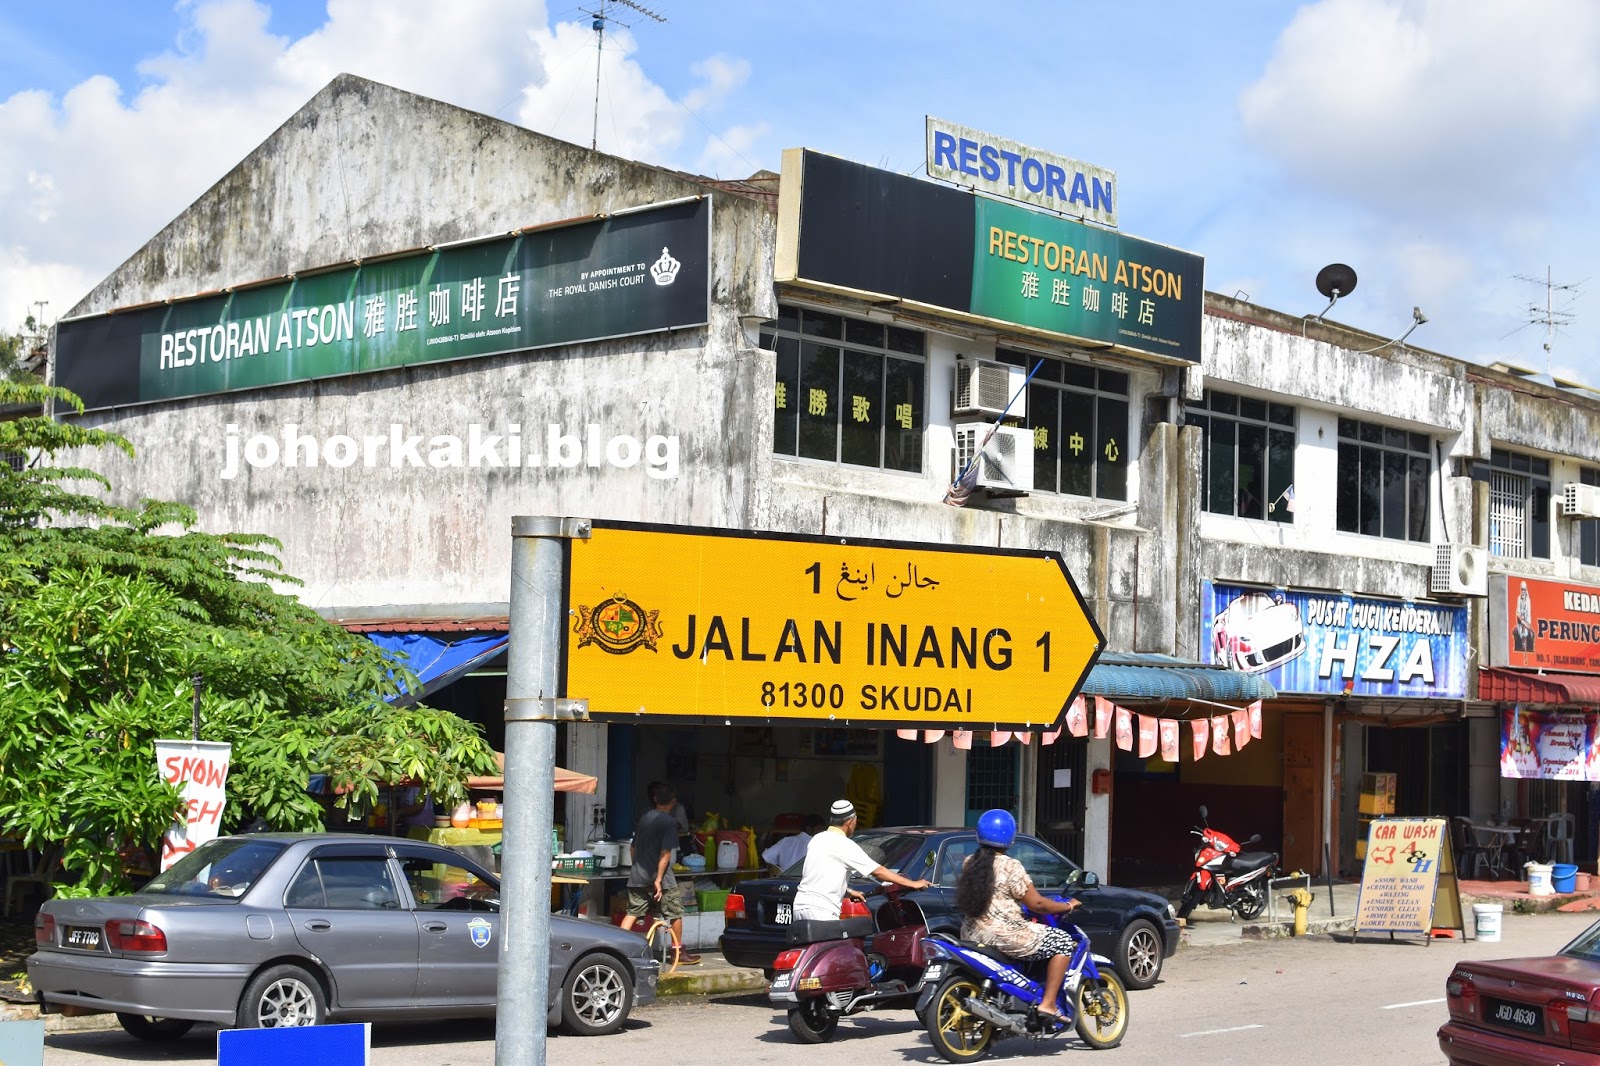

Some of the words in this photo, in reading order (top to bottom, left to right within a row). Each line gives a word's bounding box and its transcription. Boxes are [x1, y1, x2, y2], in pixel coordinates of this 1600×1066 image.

[934, 130, 1113, 214] RESTORAN
[581, 272, 588, 280] BY
[590, 264, 635, 279] APPOINTMENT
[637, 262, 646, 270] TO
[989, 226, 1109, 282] RESTORAN
[1114, 260, 1183, 301] ATSON
[363, 271, 521, 338] 雅胜咖啡店
[549, 287, 563, 298] THE
[565, 284, 587, 295] ROYAL
[589, 280, 618, 292] DANISH
[619, 274, 646, 287] COURT
[1021, 271, 1156, 327] 雅胜咖啡店
[160, 315, 272, 370] RESTORAN
[275, 302, 354, 352] ATSON
[885, 562, 940, 598] جالن
[1307, 598, 1350, 627] PUSAT
[1351, 602, 1381, 629] CUCI
[1382, 604, 1454, 636] KENDERAAN
[672, 614, 842, 666] JALAN
[867, 622, 1013, 671] INANG
[1035, 631, 1052, 673] 1
[1319, 631, 1436, 684] HZA
[760, 681, 845, 709] 81300
[860, 684, 972, 713] SKUDAI
[165, 755, 227, 789] SNOW
[1375, 825, 1397, 839] CAR
[1403, 825, 1438, 839] WASH
[775, 913, 792, 925] 4971
[1495, 1004, 1512, 1021] JGD
[1513, 1008, 1536, 1026] 4630
